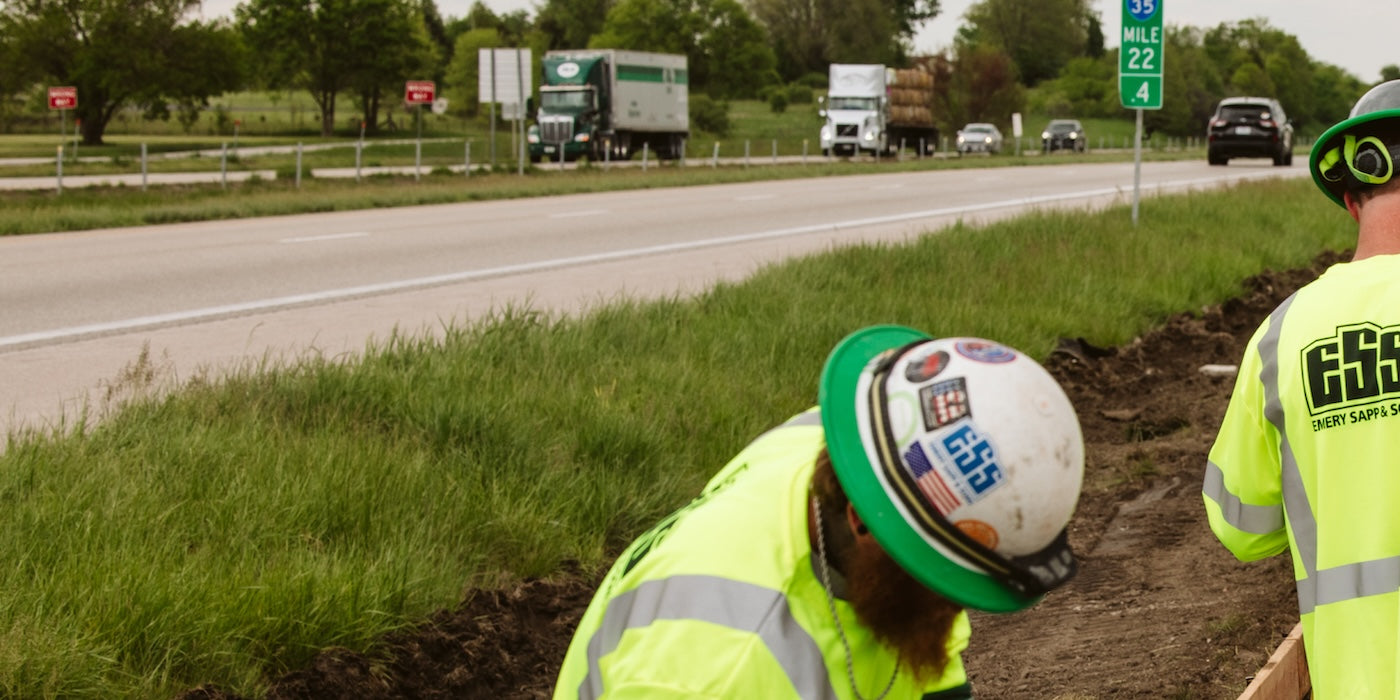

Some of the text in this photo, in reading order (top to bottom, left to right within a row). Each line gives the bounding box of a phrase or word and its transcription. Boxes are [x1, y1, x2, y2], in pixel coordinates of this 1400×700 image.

[1131, 0, 1154, 14] 35
[1123, 26, 1160, 43] MILE
[1128, 47, 1155, 69] 22
[1311, 413, 1347, 432] EMERY
[1349, 408, 1381, 424] SAPP
[1380, 405, 1388, 418] &
